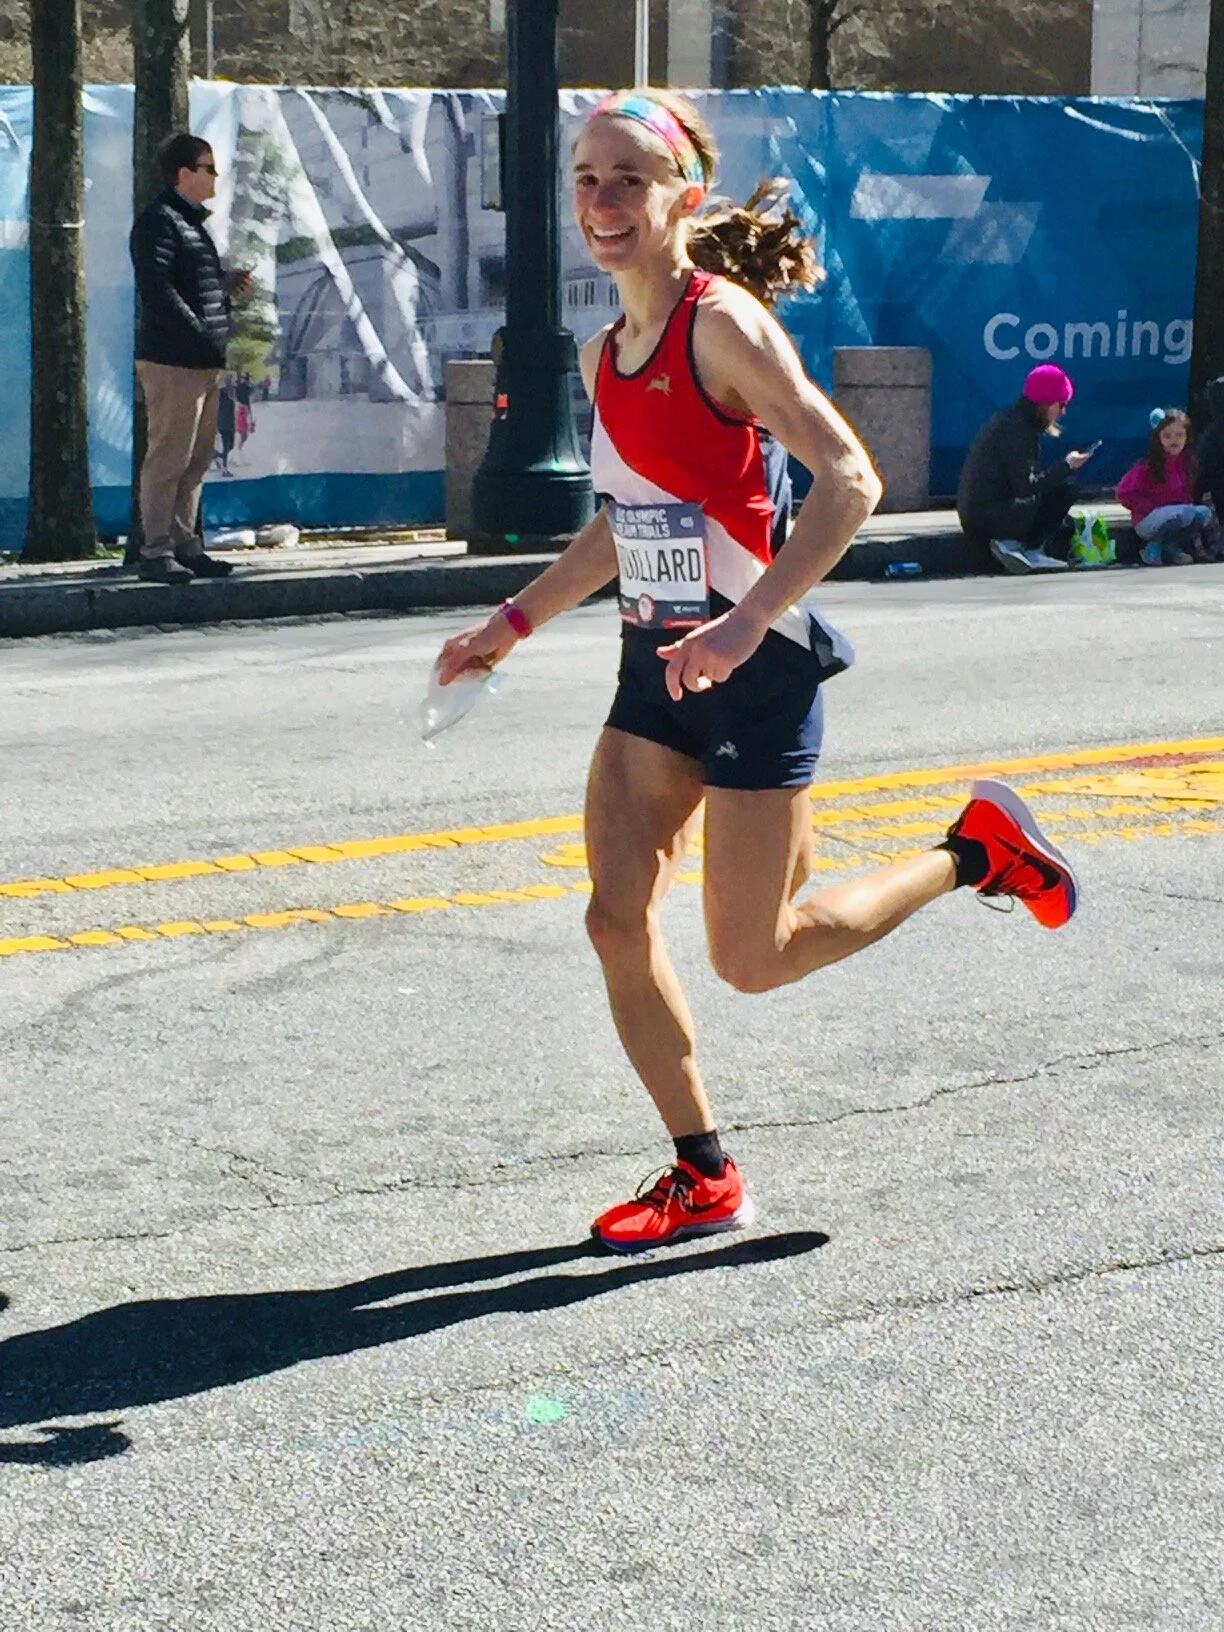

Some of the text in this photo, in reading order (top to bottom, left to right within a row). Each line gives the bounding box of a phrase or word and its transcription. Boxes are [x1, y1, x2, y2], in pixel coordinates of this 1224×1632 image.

[983, 310, 1194, 364] Coming
[626, 509, 668, 524] OLYMPIC
[619, 547, 702, 583] UILLARD
